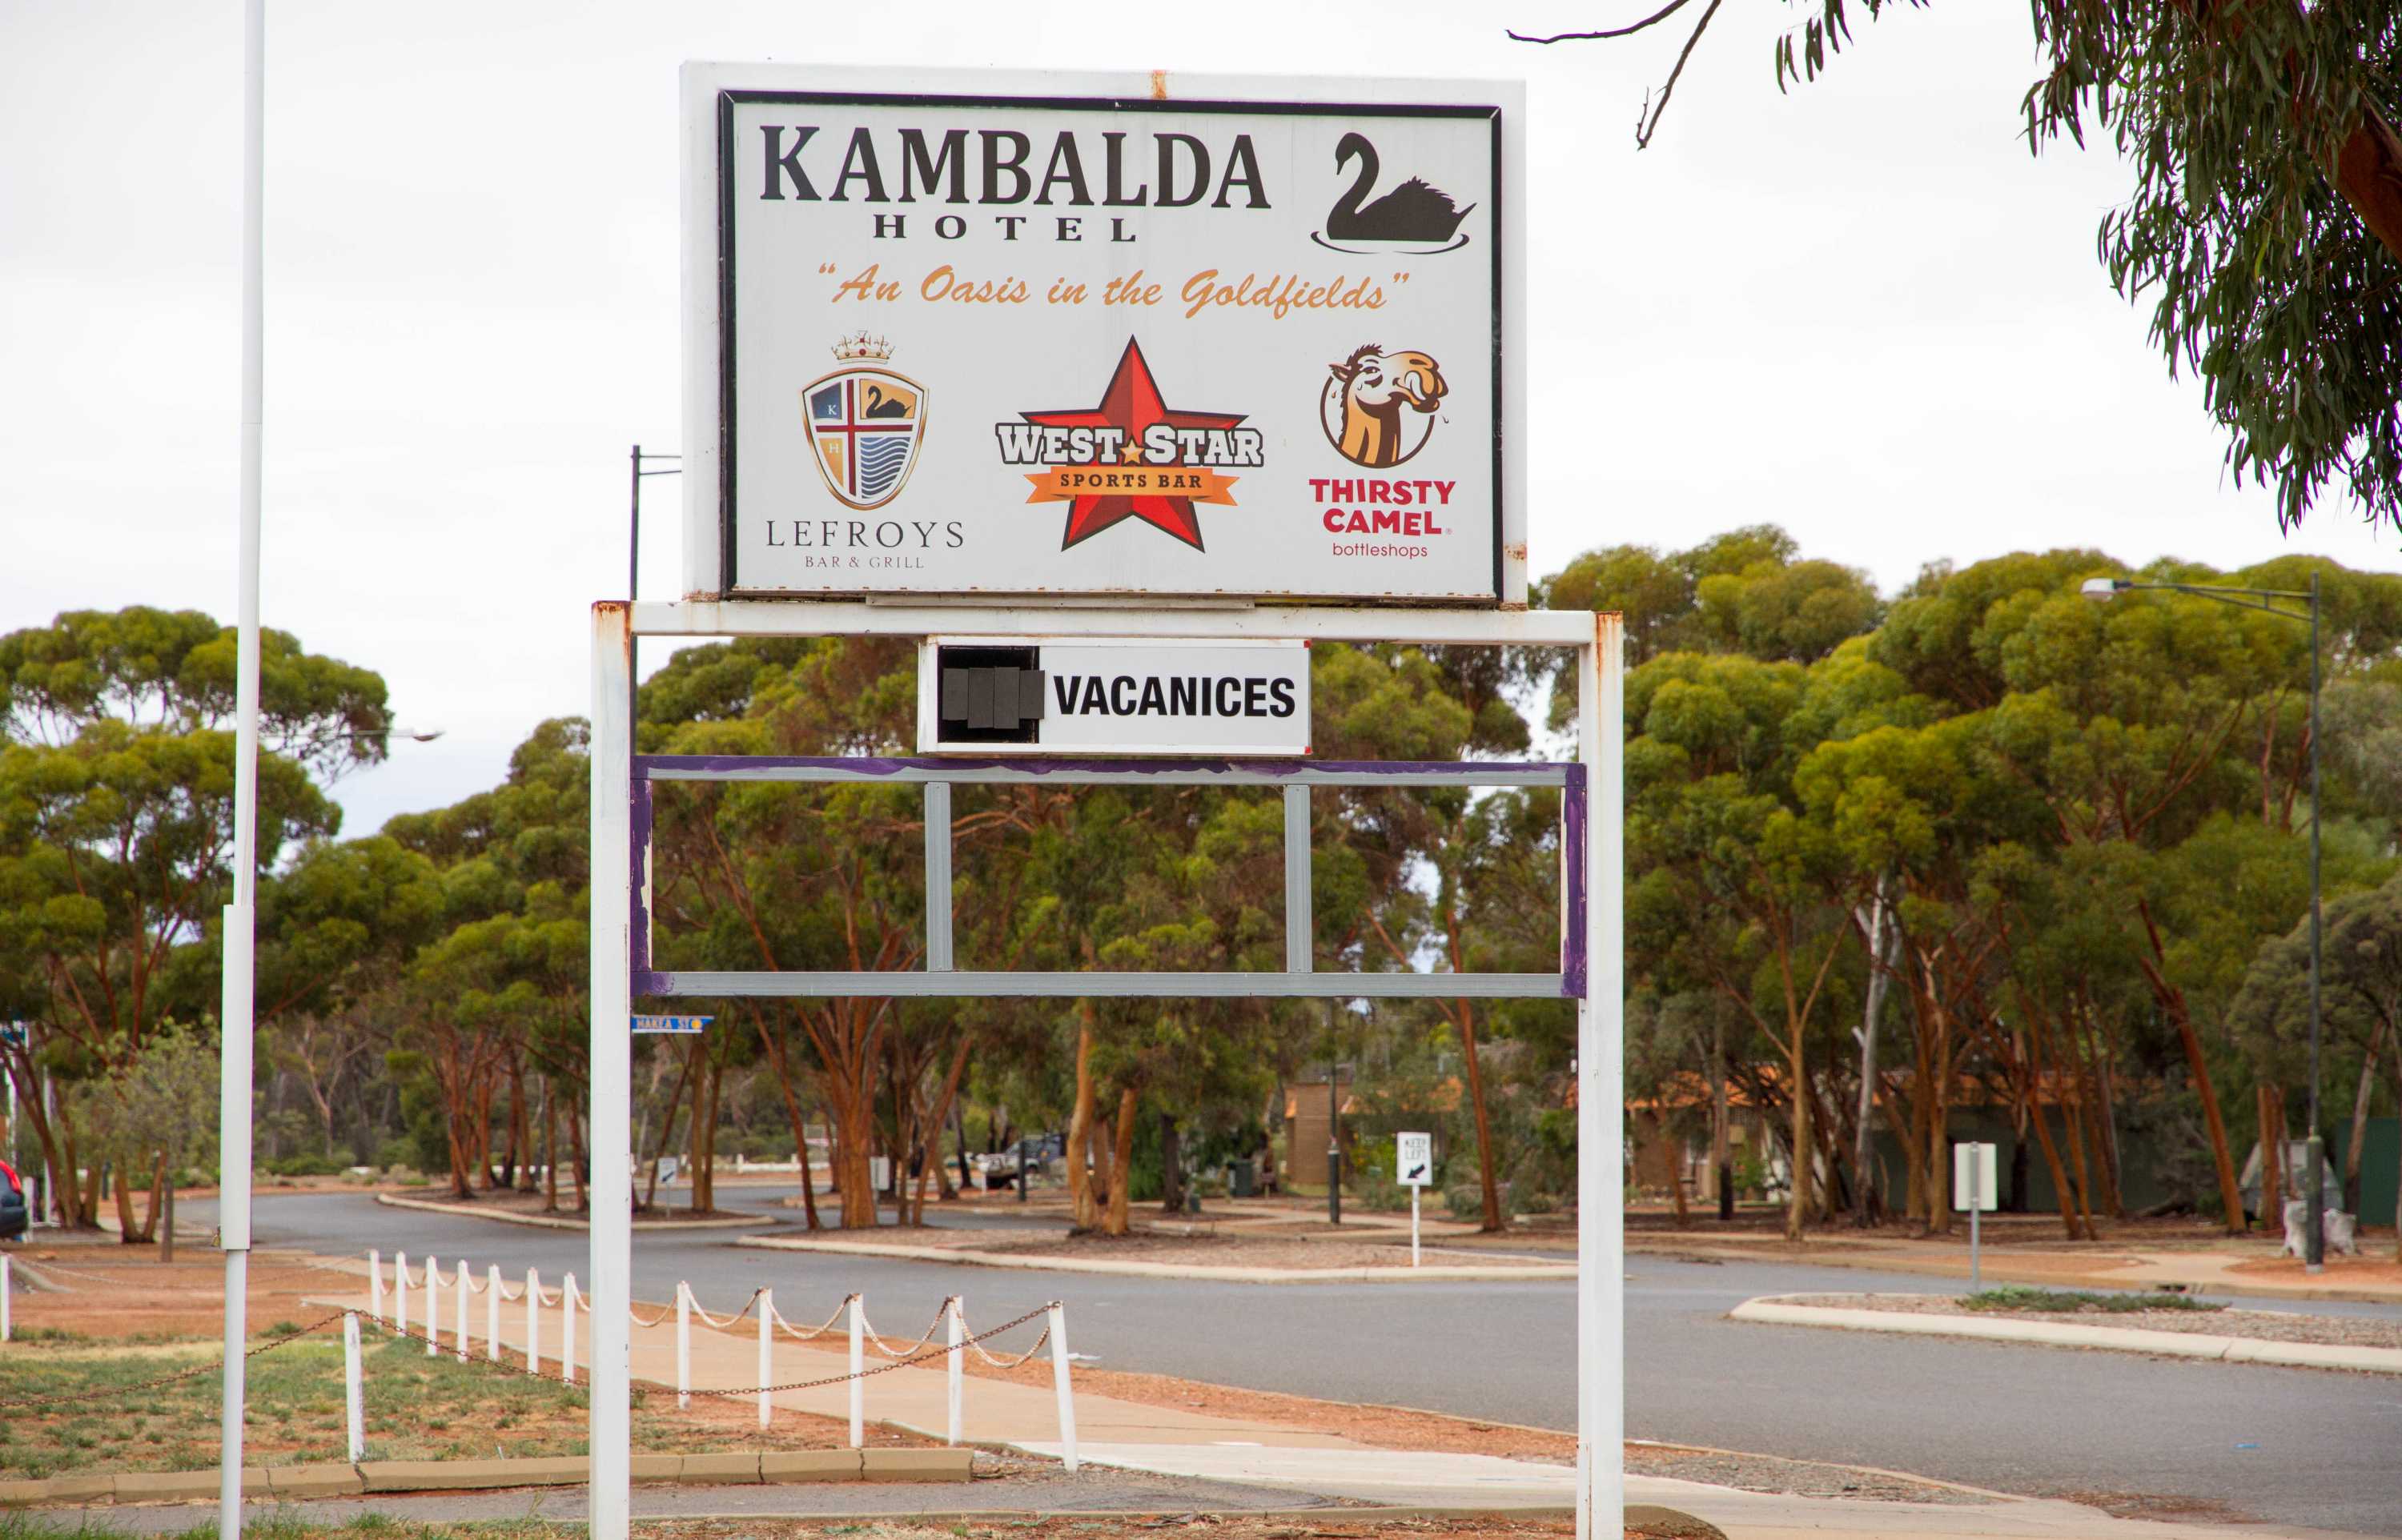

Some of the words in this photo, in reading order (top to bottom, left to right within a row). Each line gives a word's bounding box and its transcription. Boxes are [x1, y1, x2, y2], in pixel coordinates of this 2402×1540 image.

[760, 125, 1272, 210] KAMBALDA
[874, 215, 1137, 243] HOTEL
[921, 264, 1030, 304] Oasis
[1047, 277, 1089, 305] in
[1103, 269, 1163, 307] the
[826, 404, 837, 415] K
[995, 423, 1125, 465] WEST
[1143, 423, 1264, 467] STAR
[1061, 474, 1147, 487] SPORTS
[1158, 475, 1203, 488] BAR
[1309, 478, 1456, 505] THIRSTY
[766, 520, 964, 548] LEFROYS
[1323, 507, 1442, 536] CAMEL
[805, 555, 840, 568] BAR
[850, 556, 859, 568] &
[869, 556, 924, 569] GRILL
[1332, 543, 1428, 560] bottleshops
[1054, 675, 1295, 718] VACANICES
